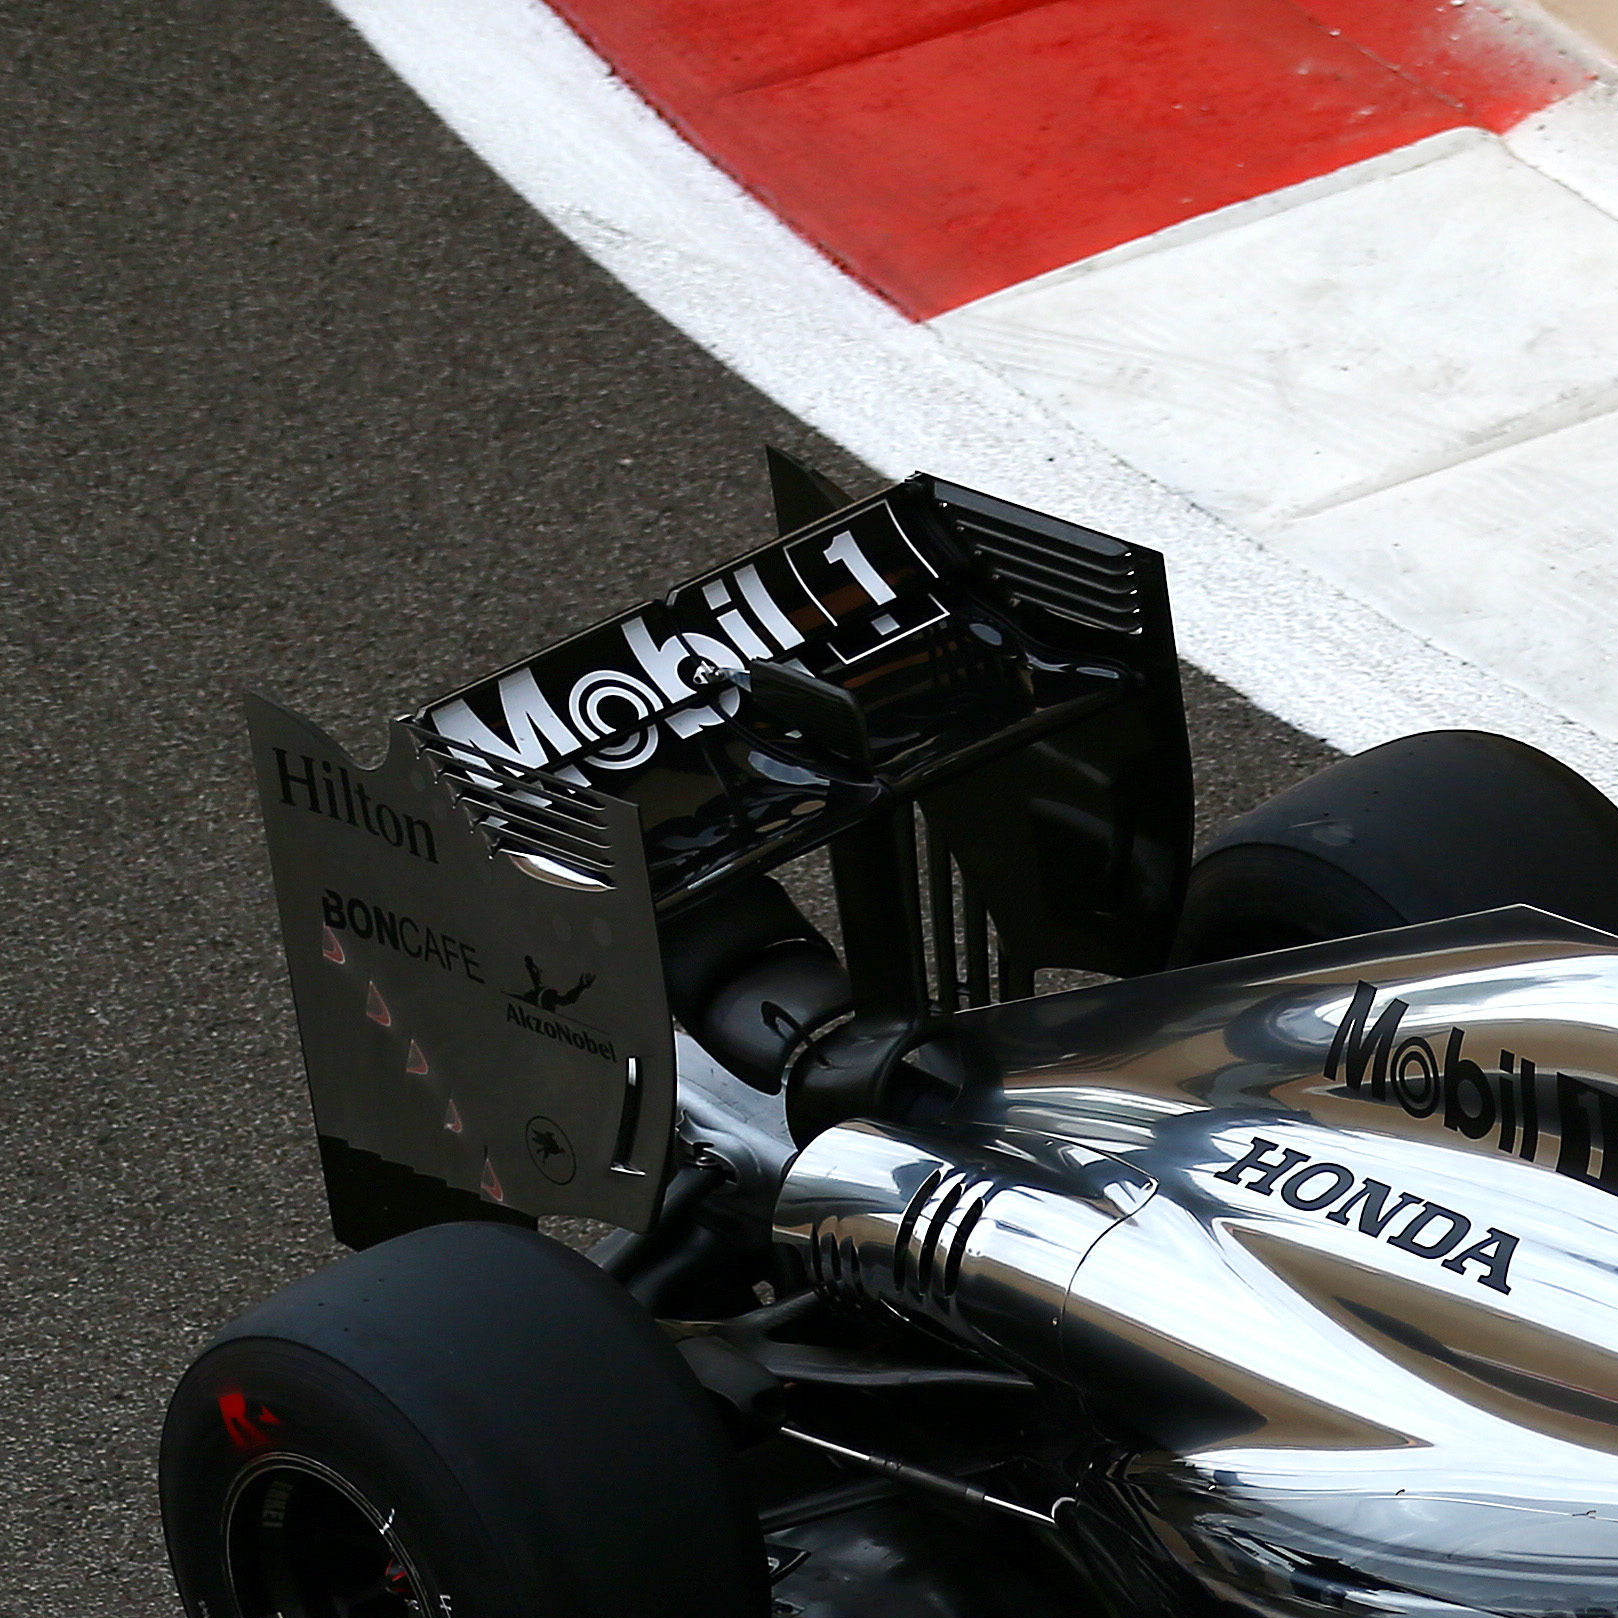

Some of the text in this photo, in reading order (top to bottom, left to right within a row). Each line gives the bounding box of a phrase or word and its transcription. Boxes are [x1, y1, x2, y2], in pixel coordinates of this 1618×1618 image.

[272, 748, 440, 865] Hilton
[323, 889, 486, 985] BONCAFE
[504, 1007, 617, 1063] AkzoNobel
[1323, 980, 1538, 1163] Mobil
[1213, 1138, 1524, 1296] HONDA
